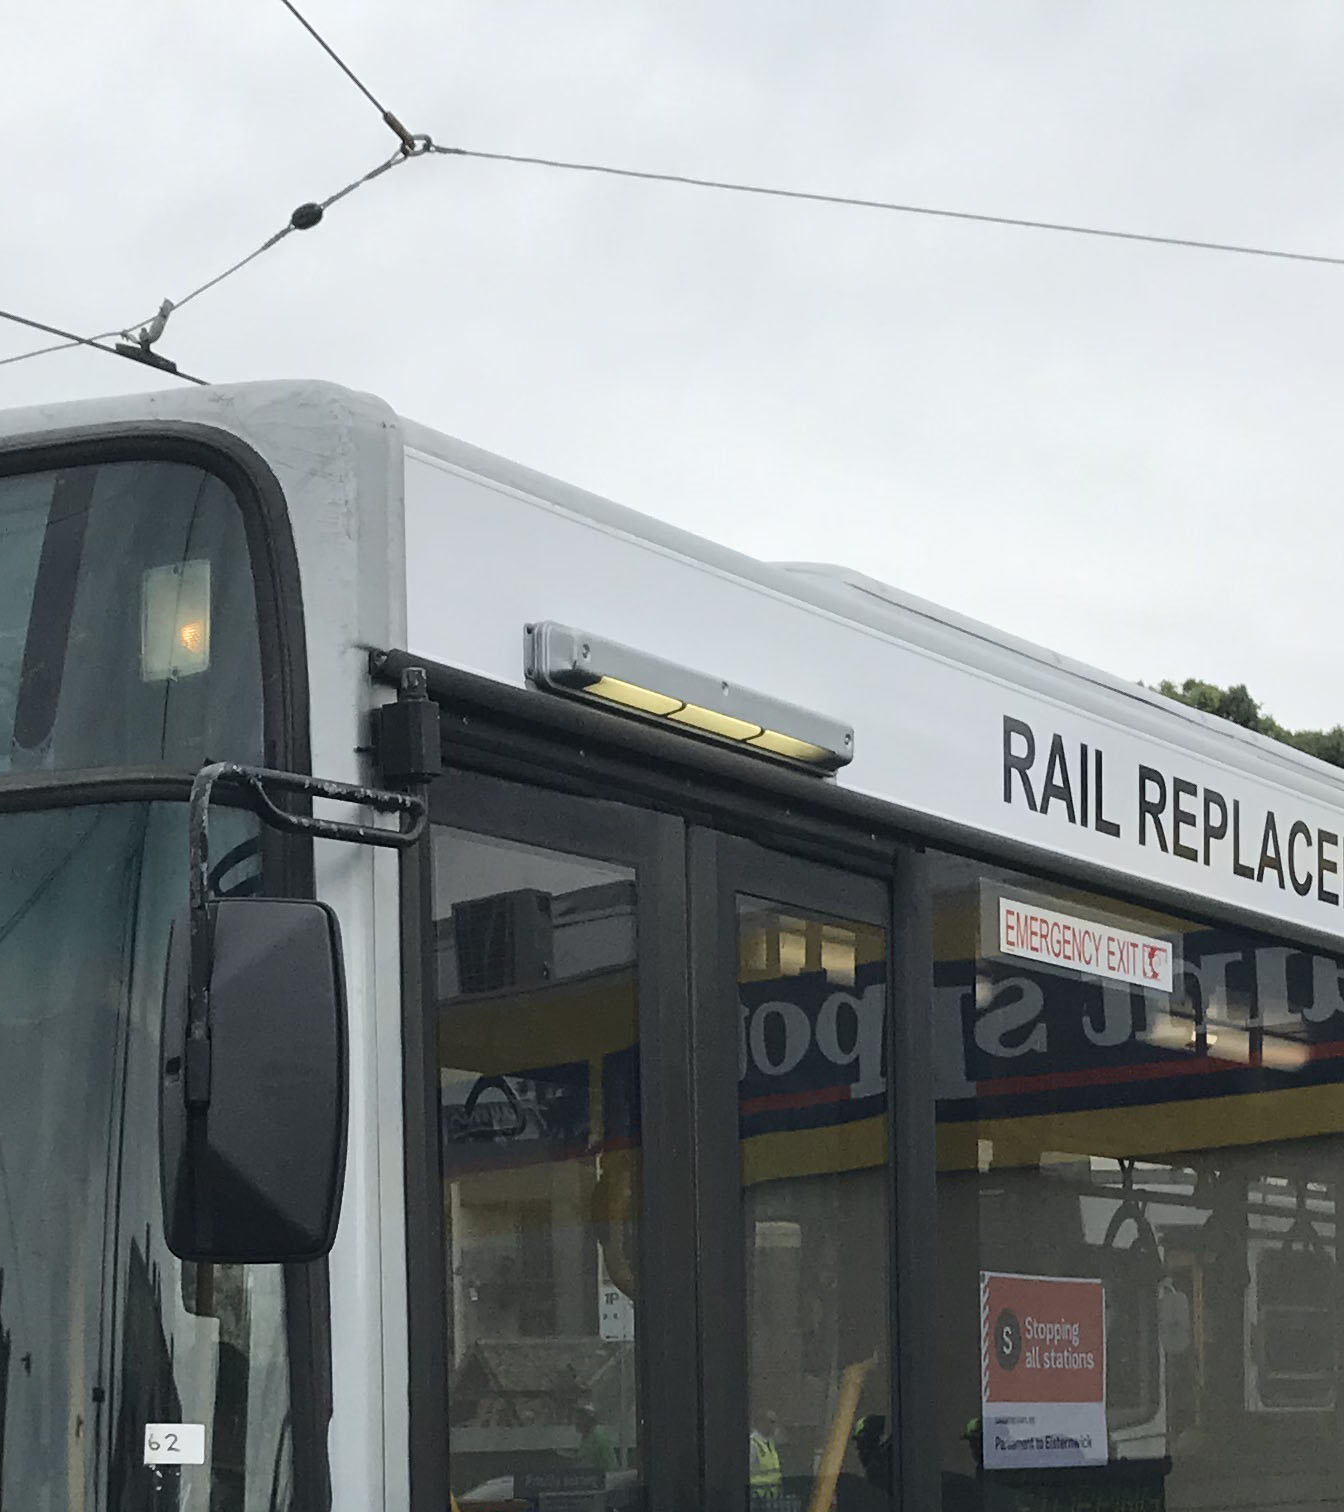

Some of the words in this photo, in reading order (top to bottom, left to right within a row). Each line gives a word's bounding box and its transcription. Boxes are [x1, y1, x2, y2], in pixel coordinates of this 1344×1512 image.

[1003, 714, 1121, 839] RAIL
[1005, 908, 1103, 967] EMERGENCY
[1107, 936, 1139, 977] EXIT
[1001, 1325, 1013, 1354] S
[1024, 1316, 1080, 1346] Stopping
[1025, 1347, 1041, 1369] all
[1044, 1347, 1095, 1370] stations
[1036, 1437, 1044, 1450] to
